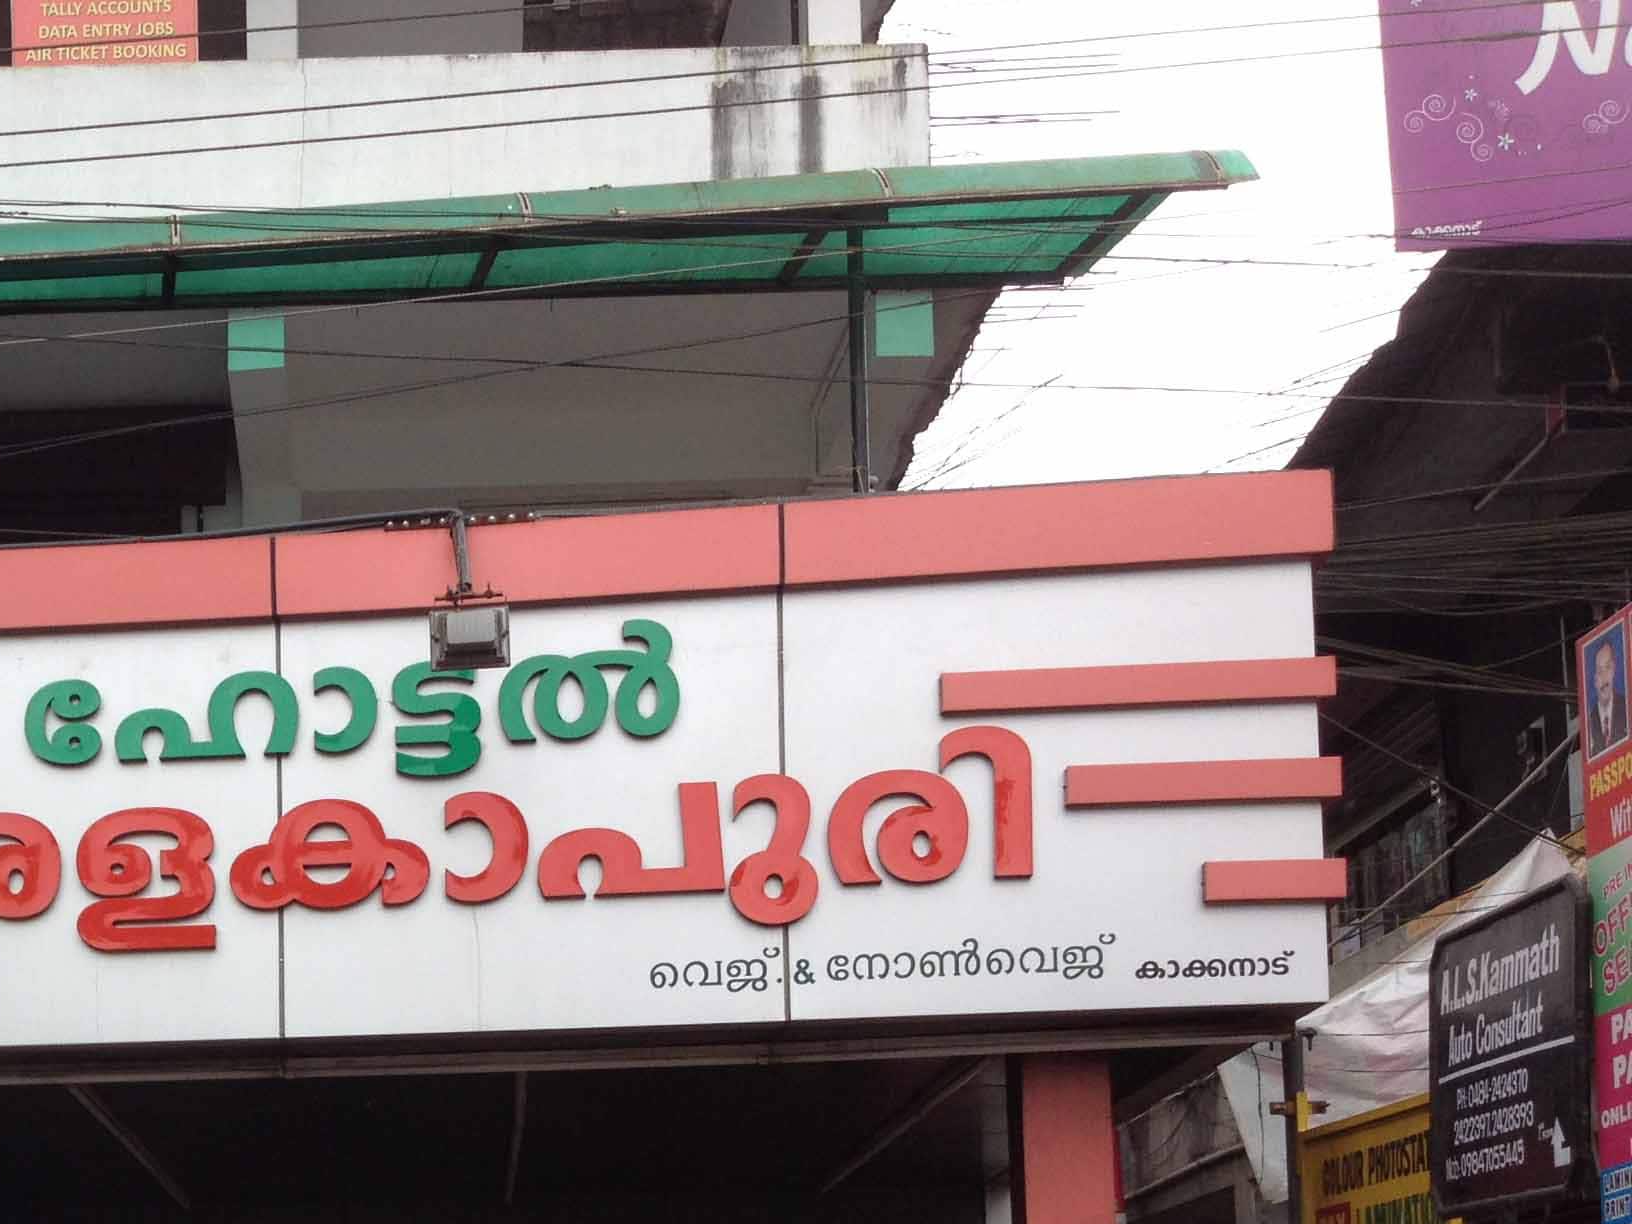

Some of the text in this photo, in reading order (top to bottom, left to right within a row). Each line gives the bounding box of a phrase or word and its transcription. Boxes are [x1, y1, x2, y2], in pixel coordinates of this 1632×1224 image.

[39, 21, 174, 39] DATA ENTRY JOBS
[41, 0, 172, 16] TALLY ACCOUNTS
[25, 43, 187, 62] AIR TICKET BOOKING
[24, 618, 680, 779] ഹോട്ടൽ
[1593, 891, 1632, 957] OFF
[793, 958, 816, 985] &
[1134, 949, 1296, 980] കാക്കനാട്
[1602, 947, 1632, 997] SE
[1448, 991, 1543, 1067] Auto Consultant
[1368, 1132, 1431, 1186] PHOTOSTA
